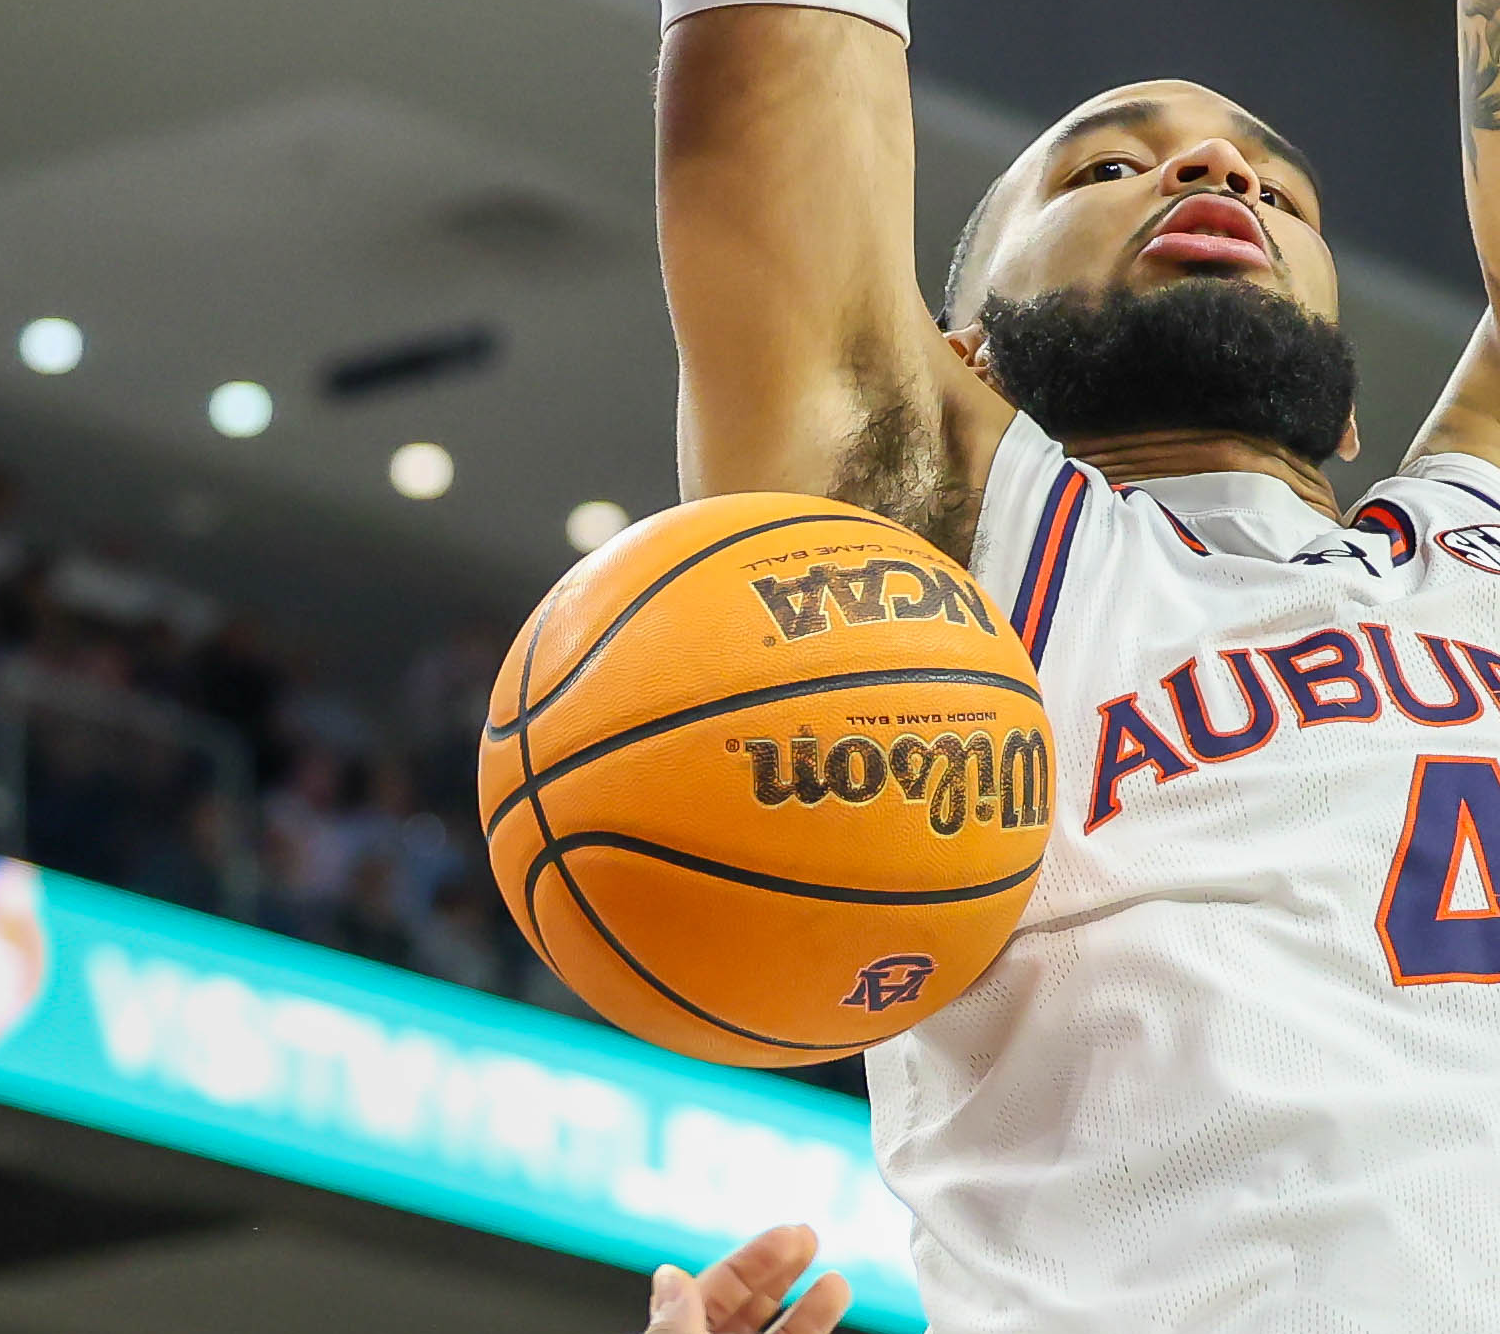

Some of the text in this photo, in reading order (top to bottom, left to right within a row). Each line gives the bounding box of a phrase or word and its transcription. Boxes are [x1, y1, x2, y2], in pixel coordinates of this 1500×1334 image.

[740, 549, 810, 573] BALL
[814, 544, 884, 557] GAME
[750, 558, 998, 643] NCAA
[846, 711, 997, 726] INDOOR GAME BALL
[744, 726, 1051, 840] Wilson
